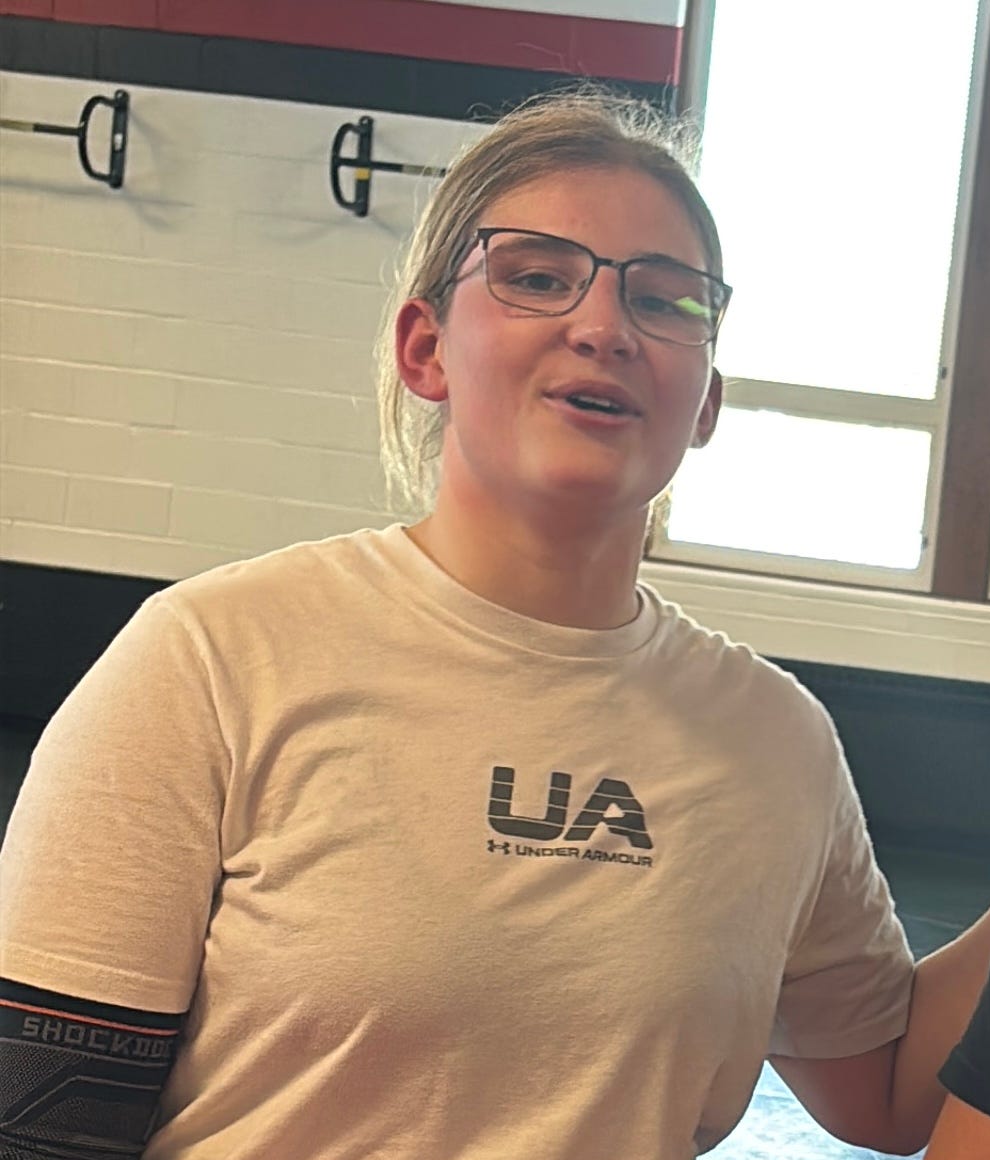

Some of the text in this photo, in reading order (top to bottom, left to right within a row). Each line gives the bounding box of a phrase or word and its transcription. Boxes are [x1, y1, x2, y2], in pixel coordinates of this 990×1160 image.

[488, 766, 653, 850] UA
[515, 844, 653, 867] UNDER ARMOUR
